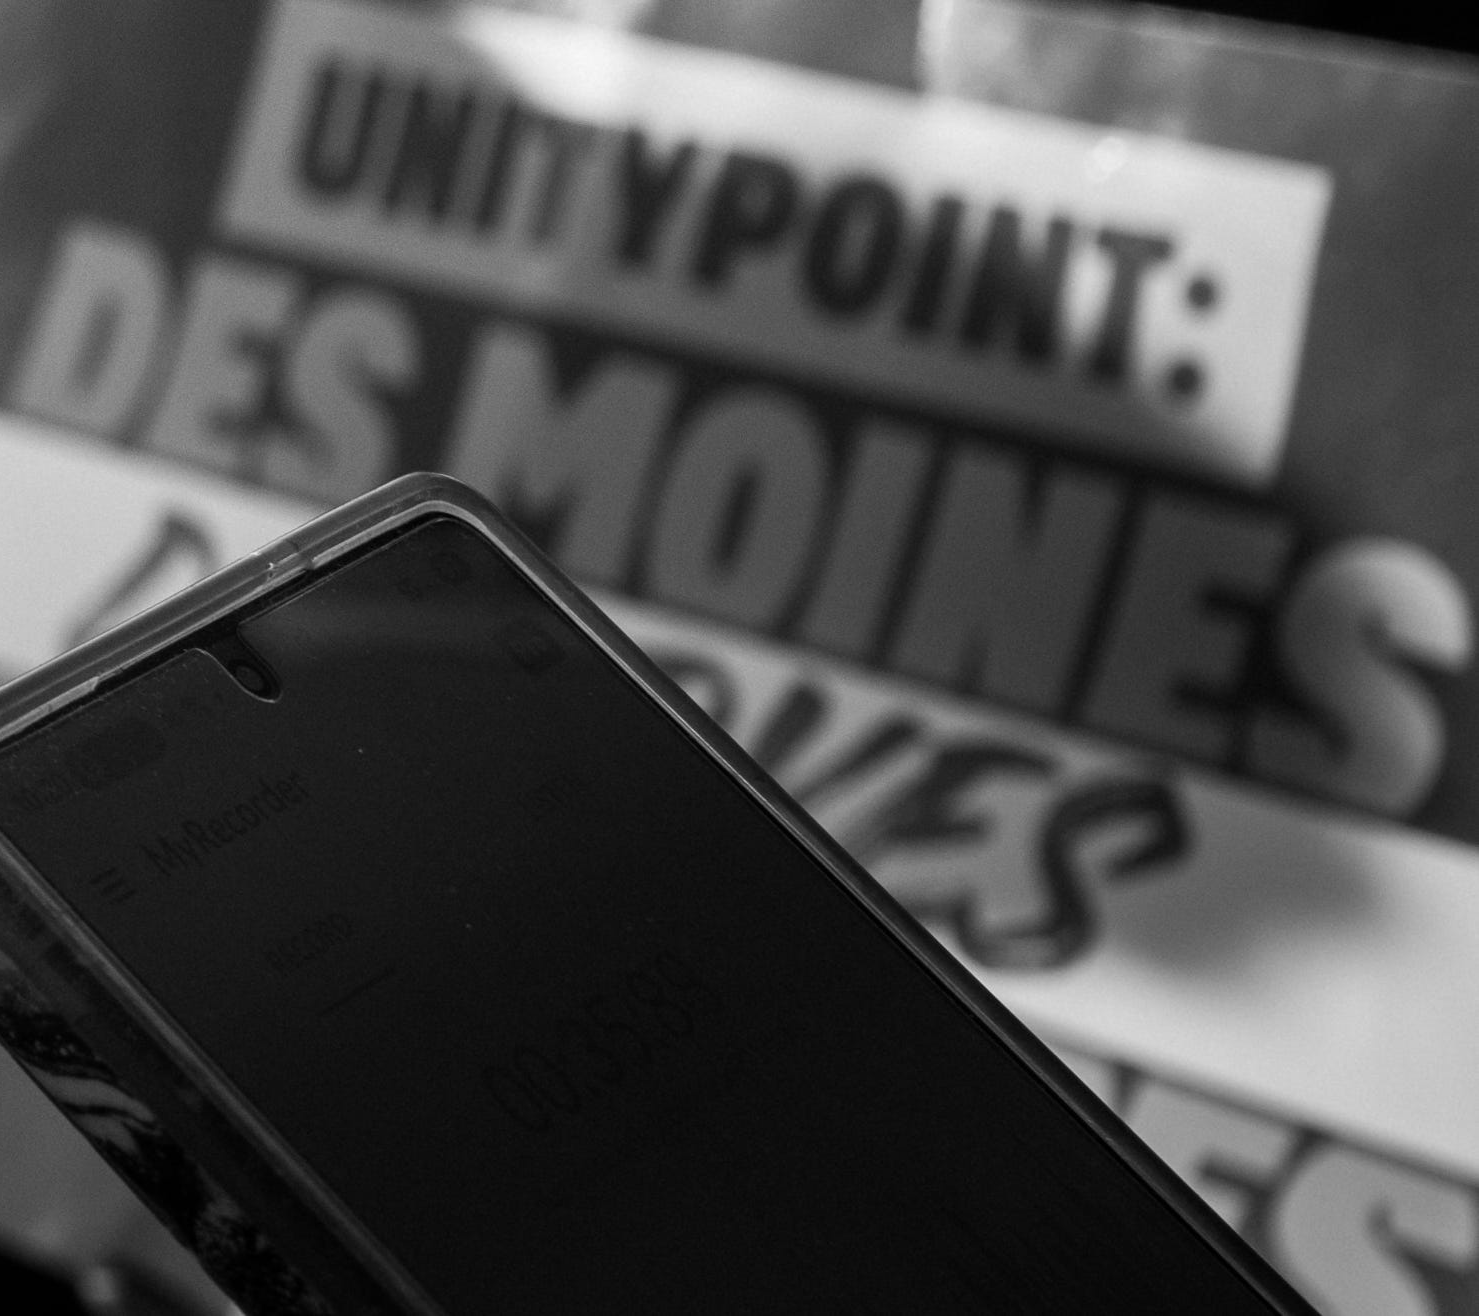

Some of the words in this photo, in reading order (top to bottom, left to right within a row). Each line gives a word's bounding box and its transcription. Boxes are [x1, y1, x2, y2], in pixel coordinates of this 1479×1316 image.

[298, 50, 1219, 400] UNITYPOINT:
[10, 213, 423, 513] DES
[443, 316, 1477, 823] MOINES
[140, 769, 313, 880] MyRecorder
